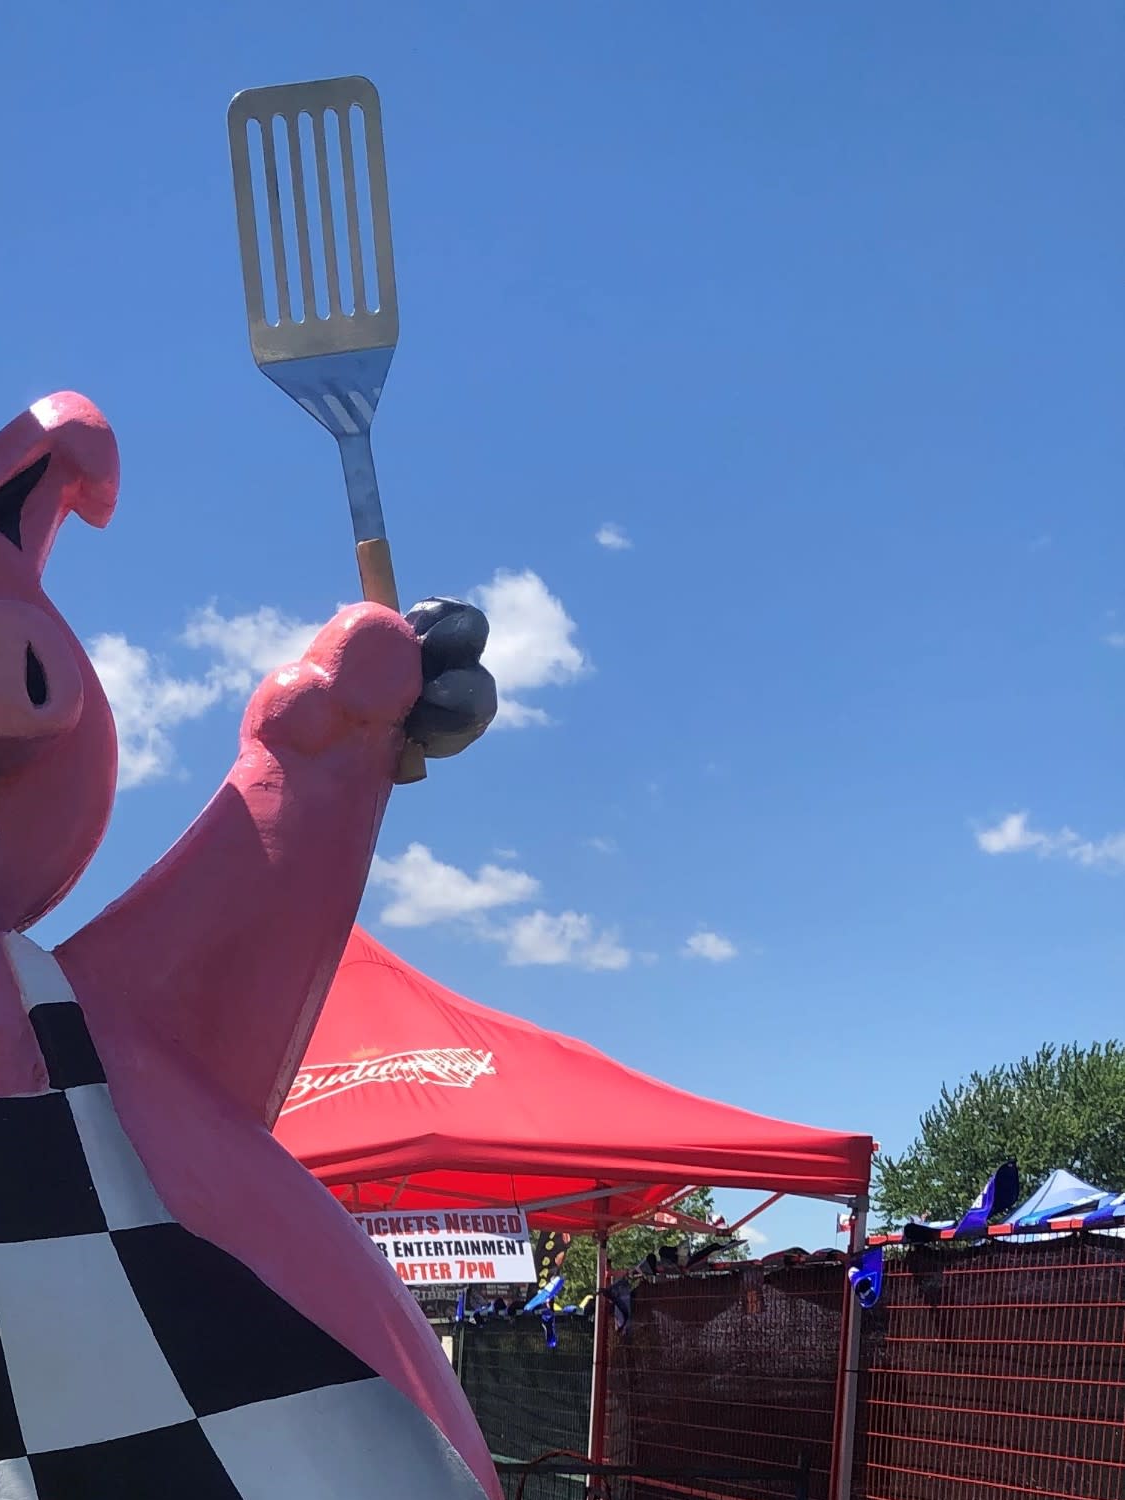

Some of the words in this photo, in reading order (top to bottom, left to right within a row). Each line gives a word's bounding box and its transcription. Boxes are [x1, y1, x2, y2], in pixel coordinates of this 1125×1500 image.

[444, 1212, 522, 1236] NEEDED
[393, 1240, 525, 1258] ENTERTAINMENT
[396, 1262, 452, 1281] AFTER
[455, 1260, 496, 1280] 7PM
